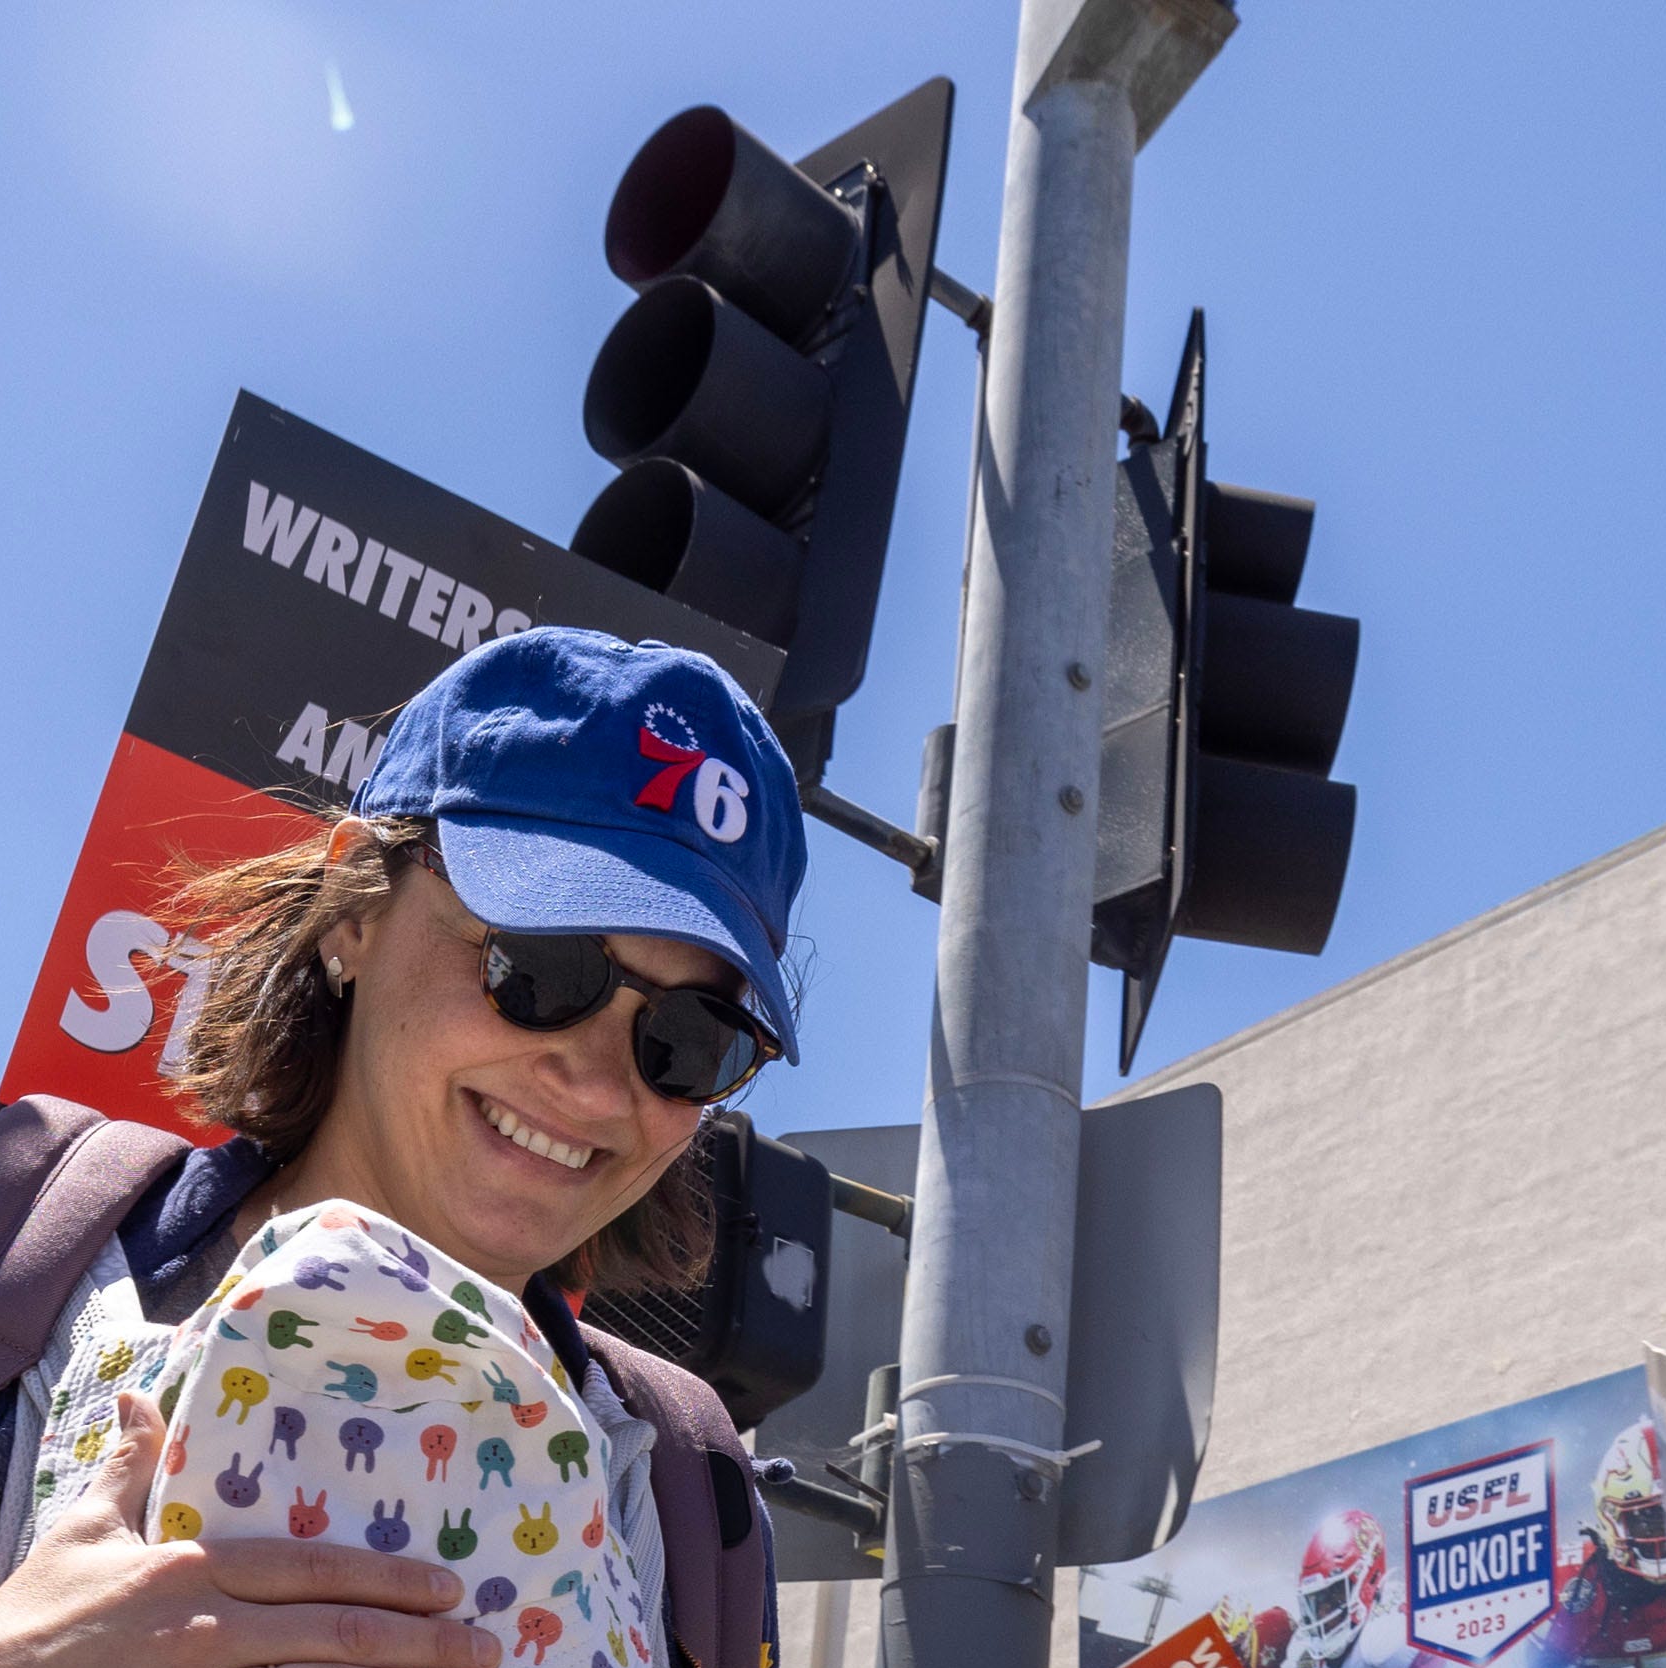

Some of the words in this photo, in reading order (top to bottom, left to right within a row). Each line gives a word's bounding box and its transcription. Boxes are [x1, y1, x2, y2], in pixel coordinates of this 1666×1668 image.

[634, 726, 750, 845] 76
[1426, 1471, 1531, 1529] USFL
[1417, 1523, 1544, 1600] KICKOFF
[1456, 1613, 1507, 1641] 2023
